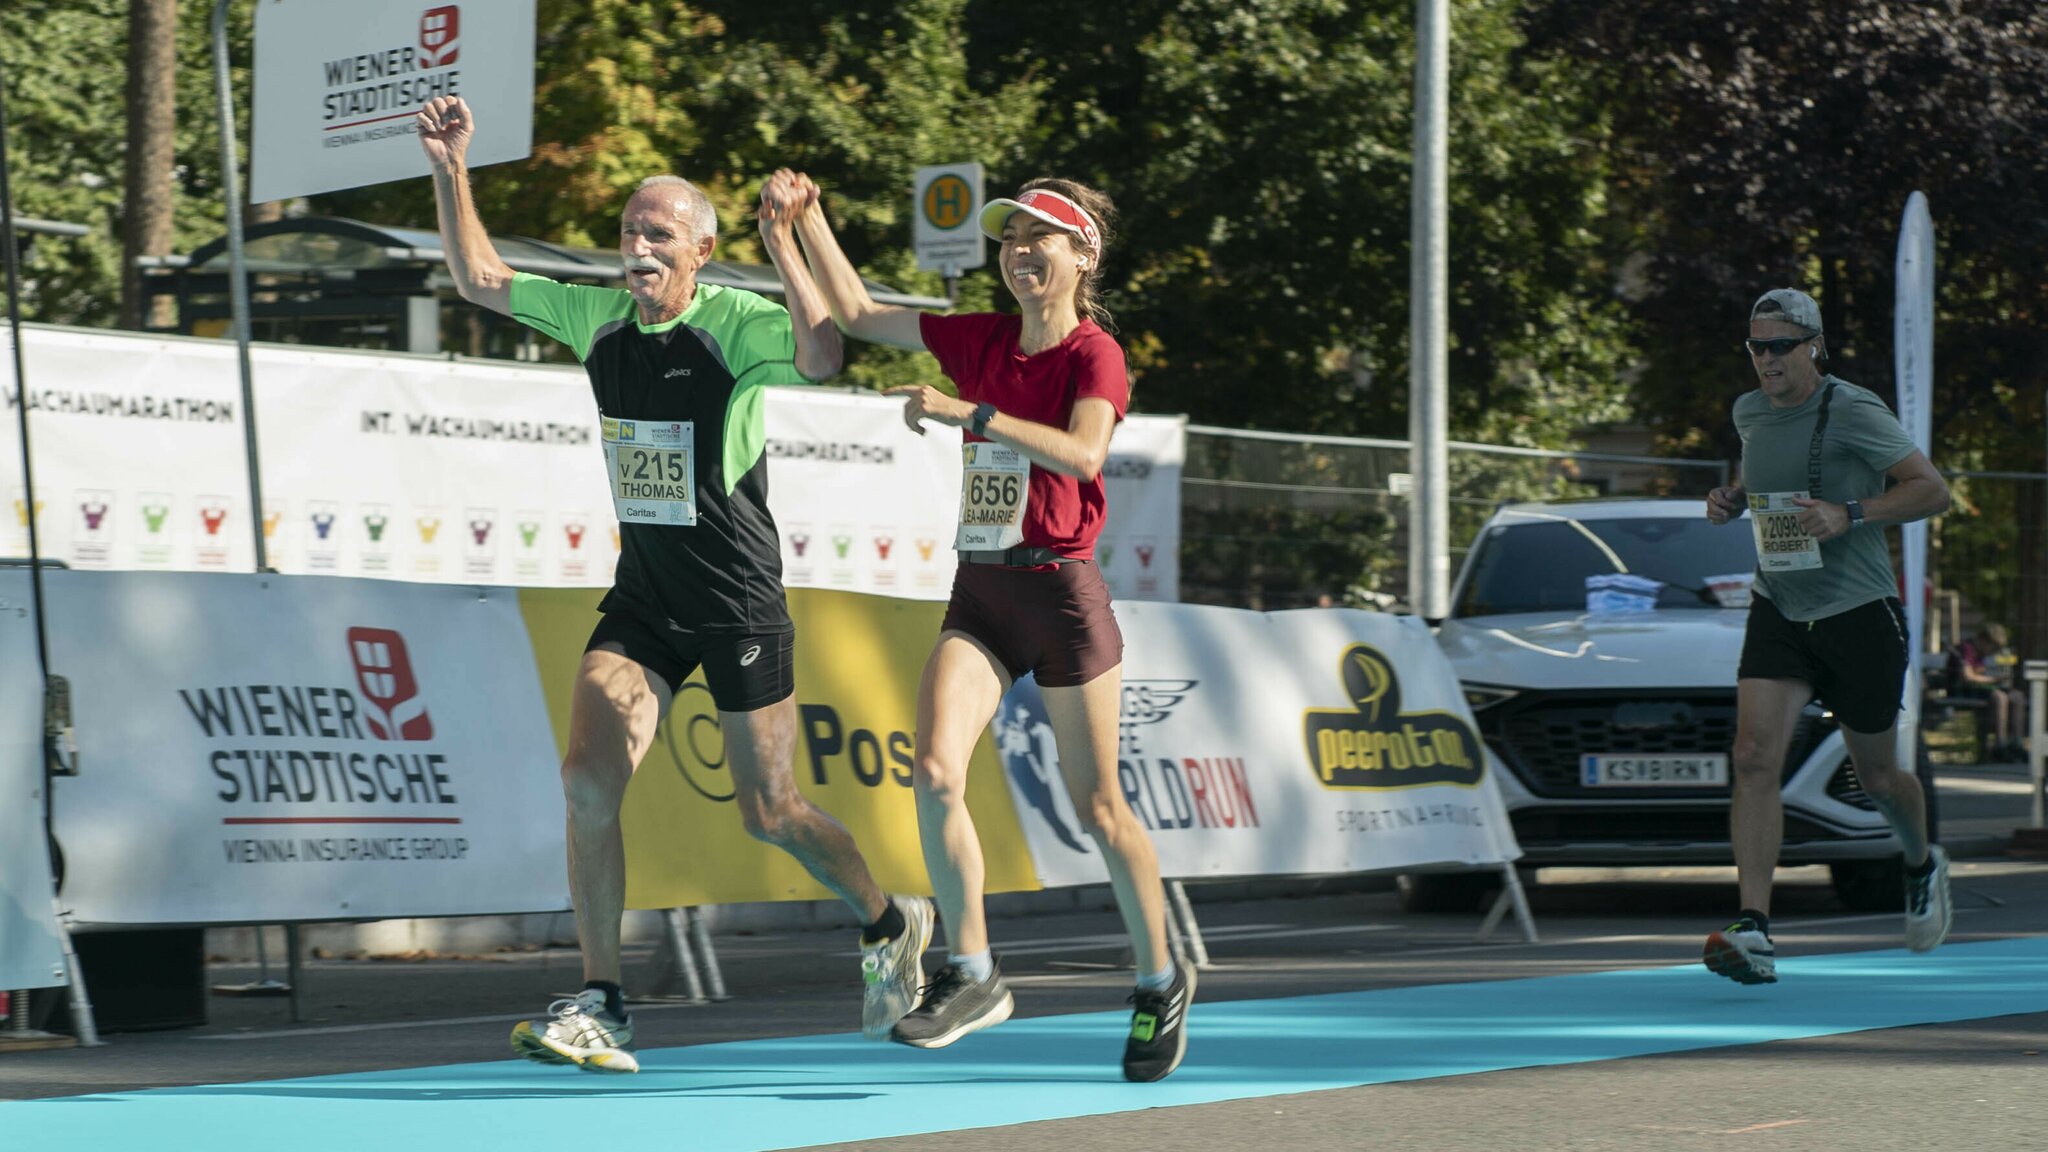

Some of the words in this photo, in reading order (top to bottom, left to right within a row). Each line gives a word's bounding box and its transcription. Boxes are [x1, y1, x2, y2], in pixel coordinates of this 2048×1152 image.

[323, 46, 416, 87] WIENER
[323, 71, 460, 120] STÄDTISCHE
[362, 121, 418, 143] INSURANC
[936, 184, 961, 220] H
[2, 386, 234, 423] WACHAUMARATHON
[361, 411, 397, 433] INT.
[404, 414, 592, 445] WACHAUMARATHON
[765, 438, 894, 464] CHAUMARATHON
[620, 482, 685, 499] THOMAS
[970, 474, 1018, 506] 656
[626, 507, 657, 517] Caritas
[965, 533, 986, 544] Caritas
[1763, 539, 1810, 552] ROBERT
[177, 685, 366, 740] WIENER
[798, 704, 916, 788] Pos
[209, 750, 458, 804] STÄDTISCHE
[222, 838, 299, 863] VIENNA
[301, 838, 408, 862] INSURANCE
[410, 837, 470, 860] GROUP
